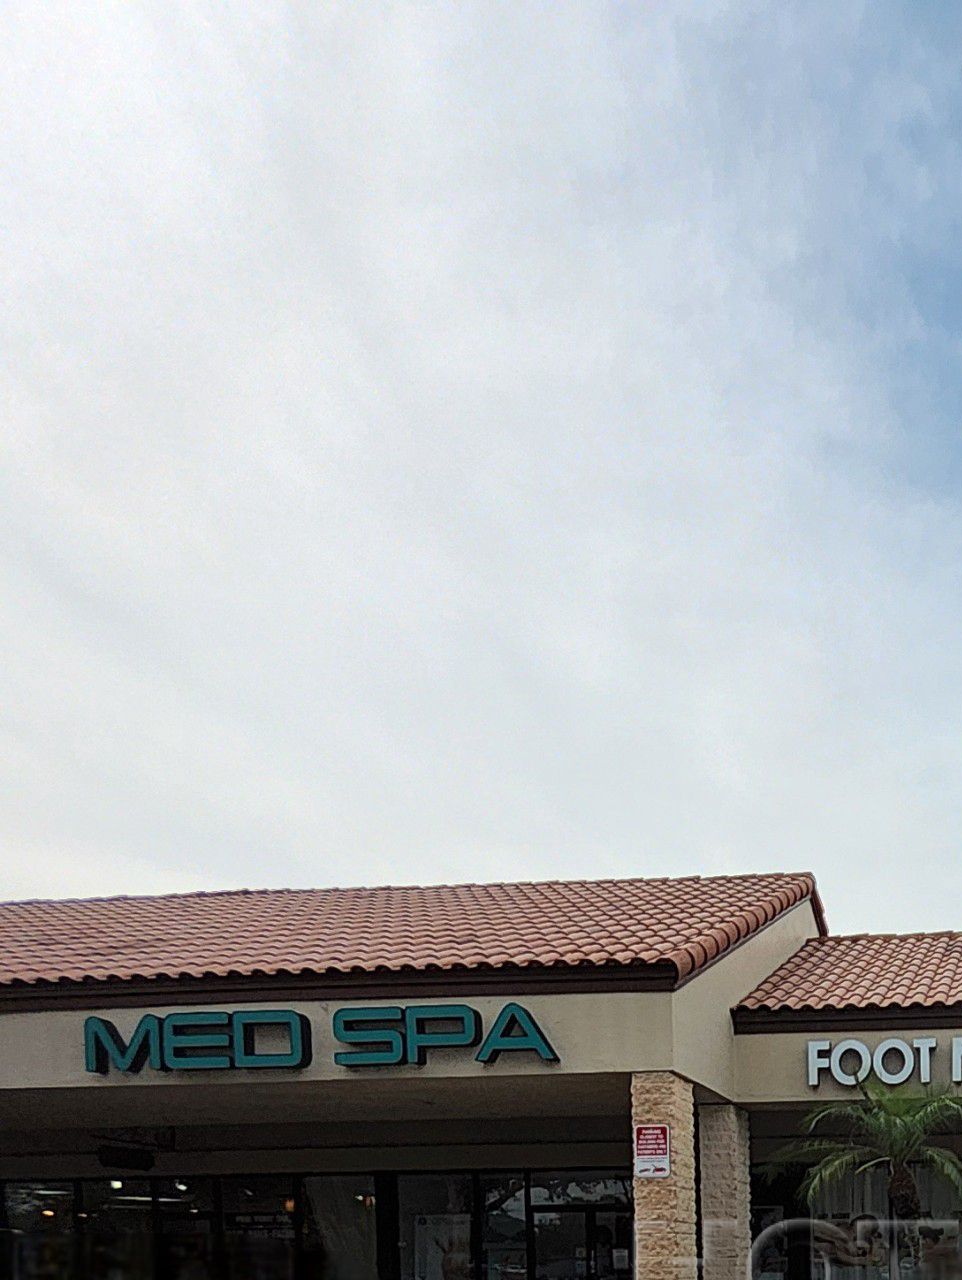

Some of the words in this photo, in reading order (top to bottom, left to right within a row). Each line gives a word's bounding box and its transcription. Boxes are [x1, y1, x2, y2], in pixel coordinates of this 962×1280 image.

[84, 1010, 311, 1074] MED
[333, 1002, 561, 1066] SPA
[808, 1037, 937, 1086] FOOT
